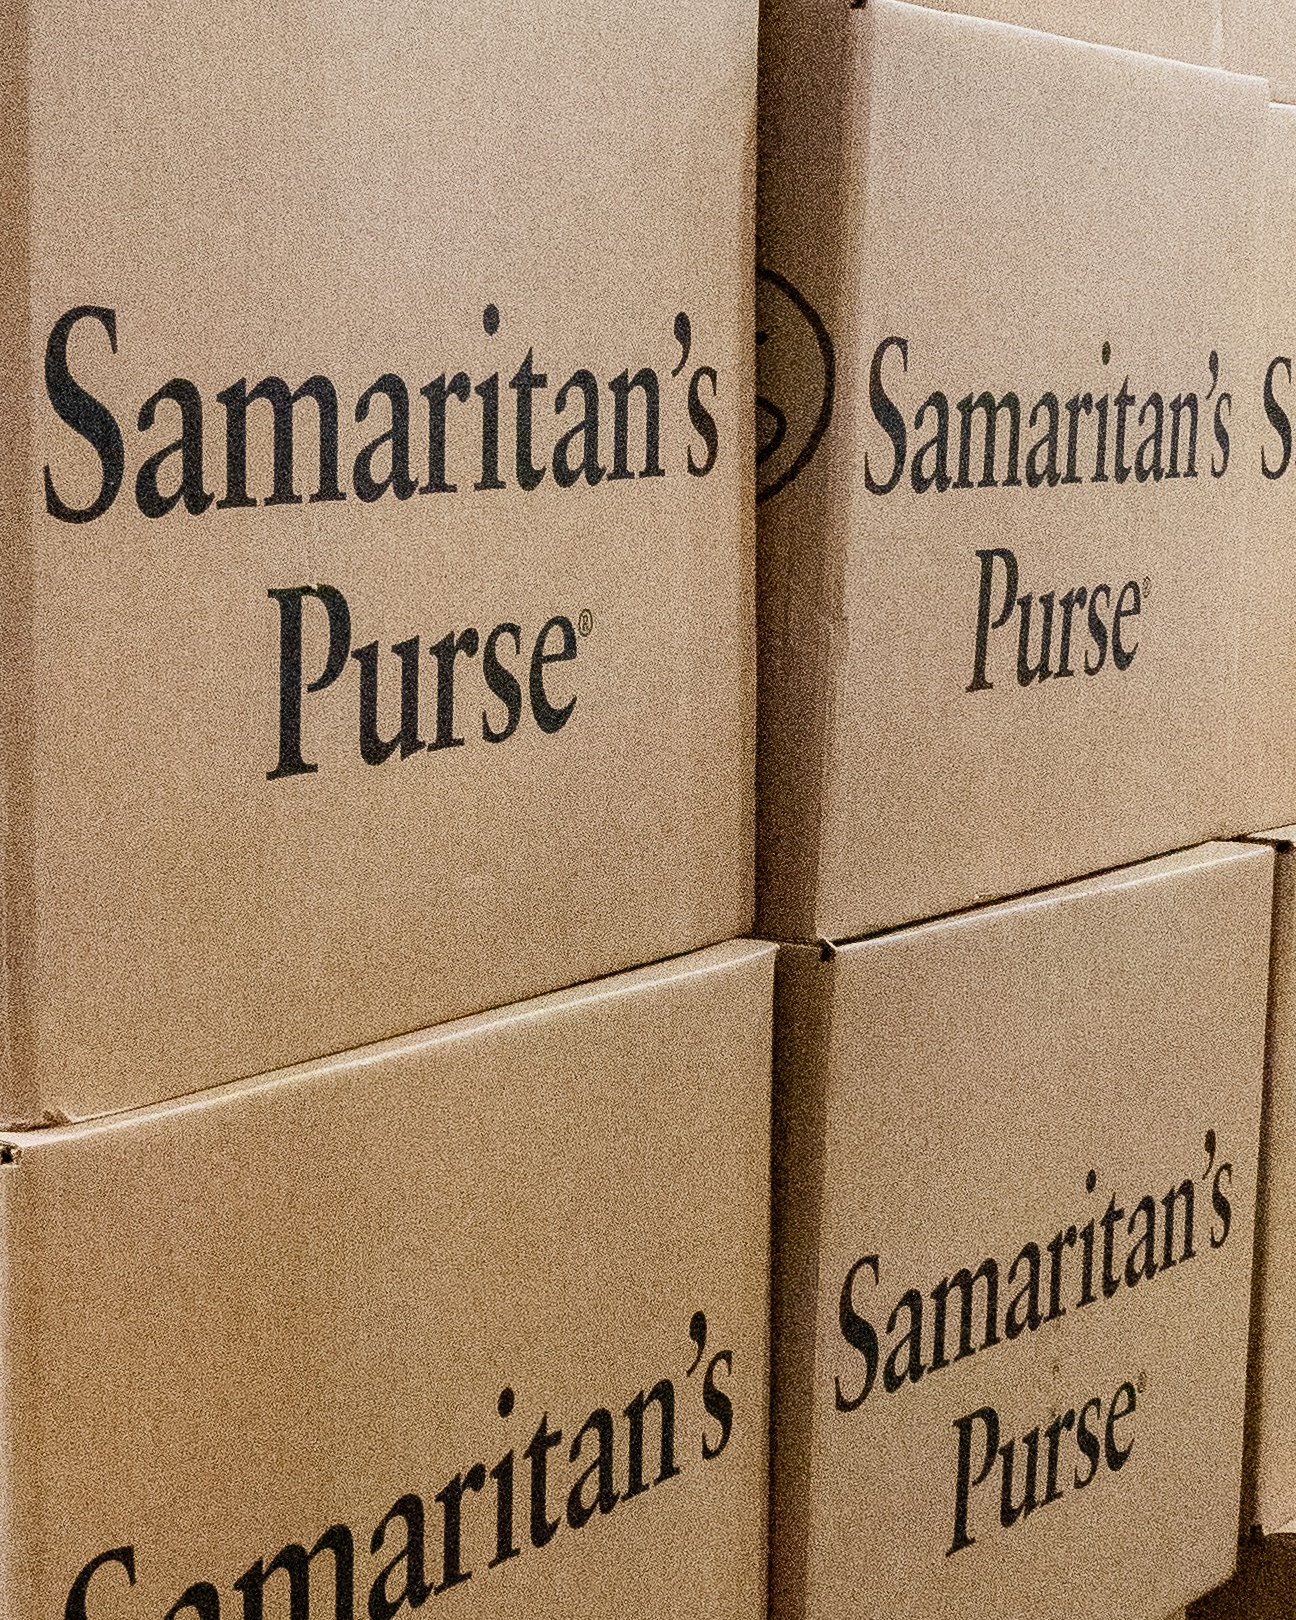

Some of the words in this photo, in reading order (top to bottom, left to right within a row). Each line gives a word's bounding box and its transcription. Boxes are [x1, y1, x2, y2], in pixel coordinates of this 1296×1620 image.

[44, 302, 718, 524] Samaritan's
[864, 336, 1232, 496] Samaritan's
[834, 1128, 1233, 1413] Samaritan's
